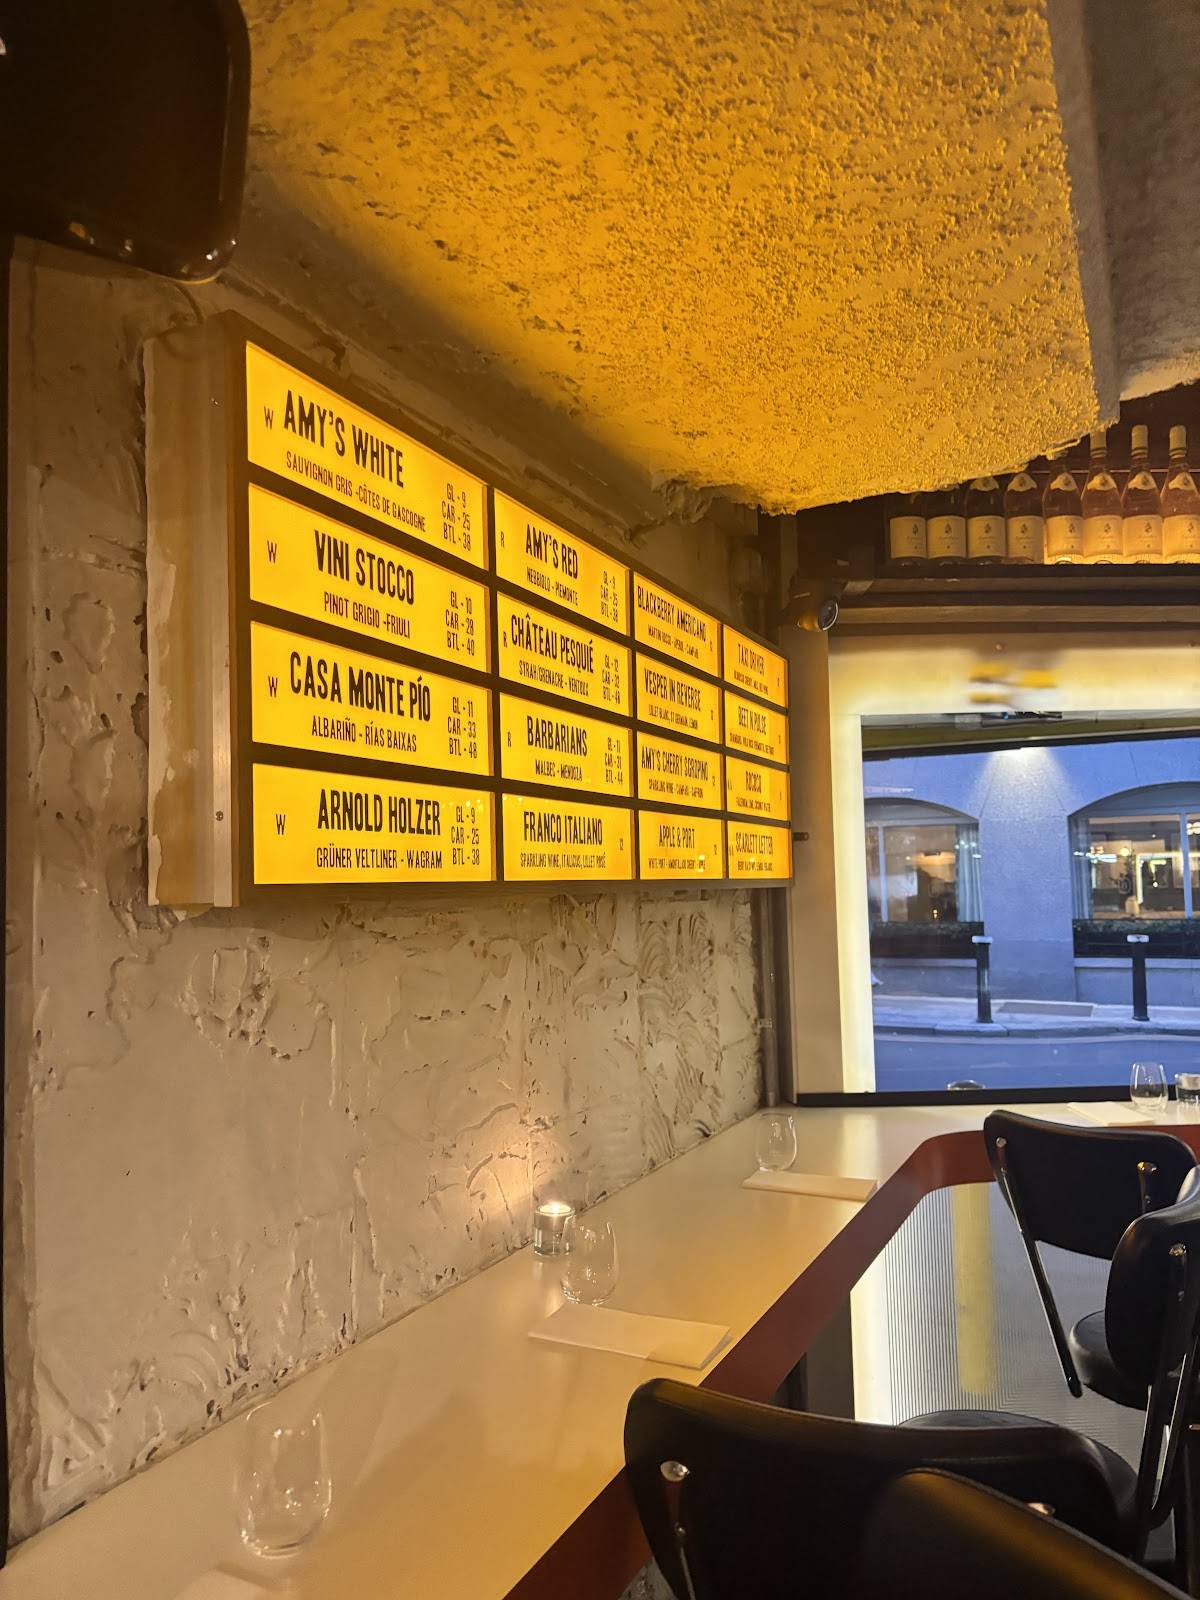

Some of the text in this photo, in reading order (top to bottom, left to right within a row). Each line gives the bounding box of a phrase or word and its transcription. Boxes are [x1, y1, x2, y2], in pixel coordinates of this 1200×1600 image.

[264, 406, 274, 429] W
[284, 390, 404, 488] AMY'S WHITE
[286, 451, 426, 532] SAUVIGNON GRIS -CÔTES DE GASCOGNE
[447, 483, 455, 502] GL
[462, 491, 466, 509] 9
[442, 501, 455, 524] CAR
[462, 512, 470, 531] 25
[443, 522, 455, 544] BTL
[463, 532, 471, 551] 38
[526, 524, 559, 569] AMY'S
[267, 541, 277, 563] W
[314, 530, 414, 605] VINI STOCCO
[527, 566, 550, 592] NEBBIOLO
[555, 582, 578, 606] PIEMONTE
[324, 592, 410, 638] PINOT GRIGIO -FRIULI
[450, 590, 459, 609] GL
[465, 597, 472, 615] 10
[637, 585, 674, 625] BLACKBERRY
[677, 609, 706, 642] AMERICANO
[445, 609, 459, 630] CAR
[466, 617, 474, 636] 28
[447, 630, 459, 651] BTL
[467, 638, 475, 656] 40
[511, 613, 594, 674] CHÂTEAU PESQUIÉ
[268, 676, 278, 697] W
[290, 651, 431, 722] CASA MONTE PÍO
[644, 668, 667, 700] VESPER
[677, 681, 701, 711] REVERSE
[452, 696, 461, 715] GL
[467, 700, 473, 717] 11
[312, 715, 356, 742] ALBARIÑO
[365, 721, 385, 747] RÍAS
[387, 729, 417, 752] BAIXAS
[447, 716, 461, 735] CAR
[468, 721, 476, 738] 33
[527, 715, 587, 757] BARBARIANS
[449, 737, 462, 756] BTL
[468, 742, 477, 759] 48
[535, 760, 555, 777] MALBEC
[560, 764, 582, 781] MENDOZA
[662, 751, 682, 776] CHERRY
[276, 814, 286, 835] W
[317, 789, 440, 836] ARNOLD HOLZER
[456, 806, 464, 823] GL
[471, 807, 475, 824] 9
[451, 826, 464, 844] CAR
[471, 828, 479, 845] 25
[524, 811, 602, 845] FRANCO ITALIANO
[659, 825, 675, 847] APPLE
[682, 827, 695, 848] PORT
[317, 843, 352, 868] GRÜNER
[355, 848, 397, 869] VELTLINER
[406, 849, 442, 869] WAGRAM
[452, 847, 465, 865] BTL
[472, 848, 480, 866] 38
